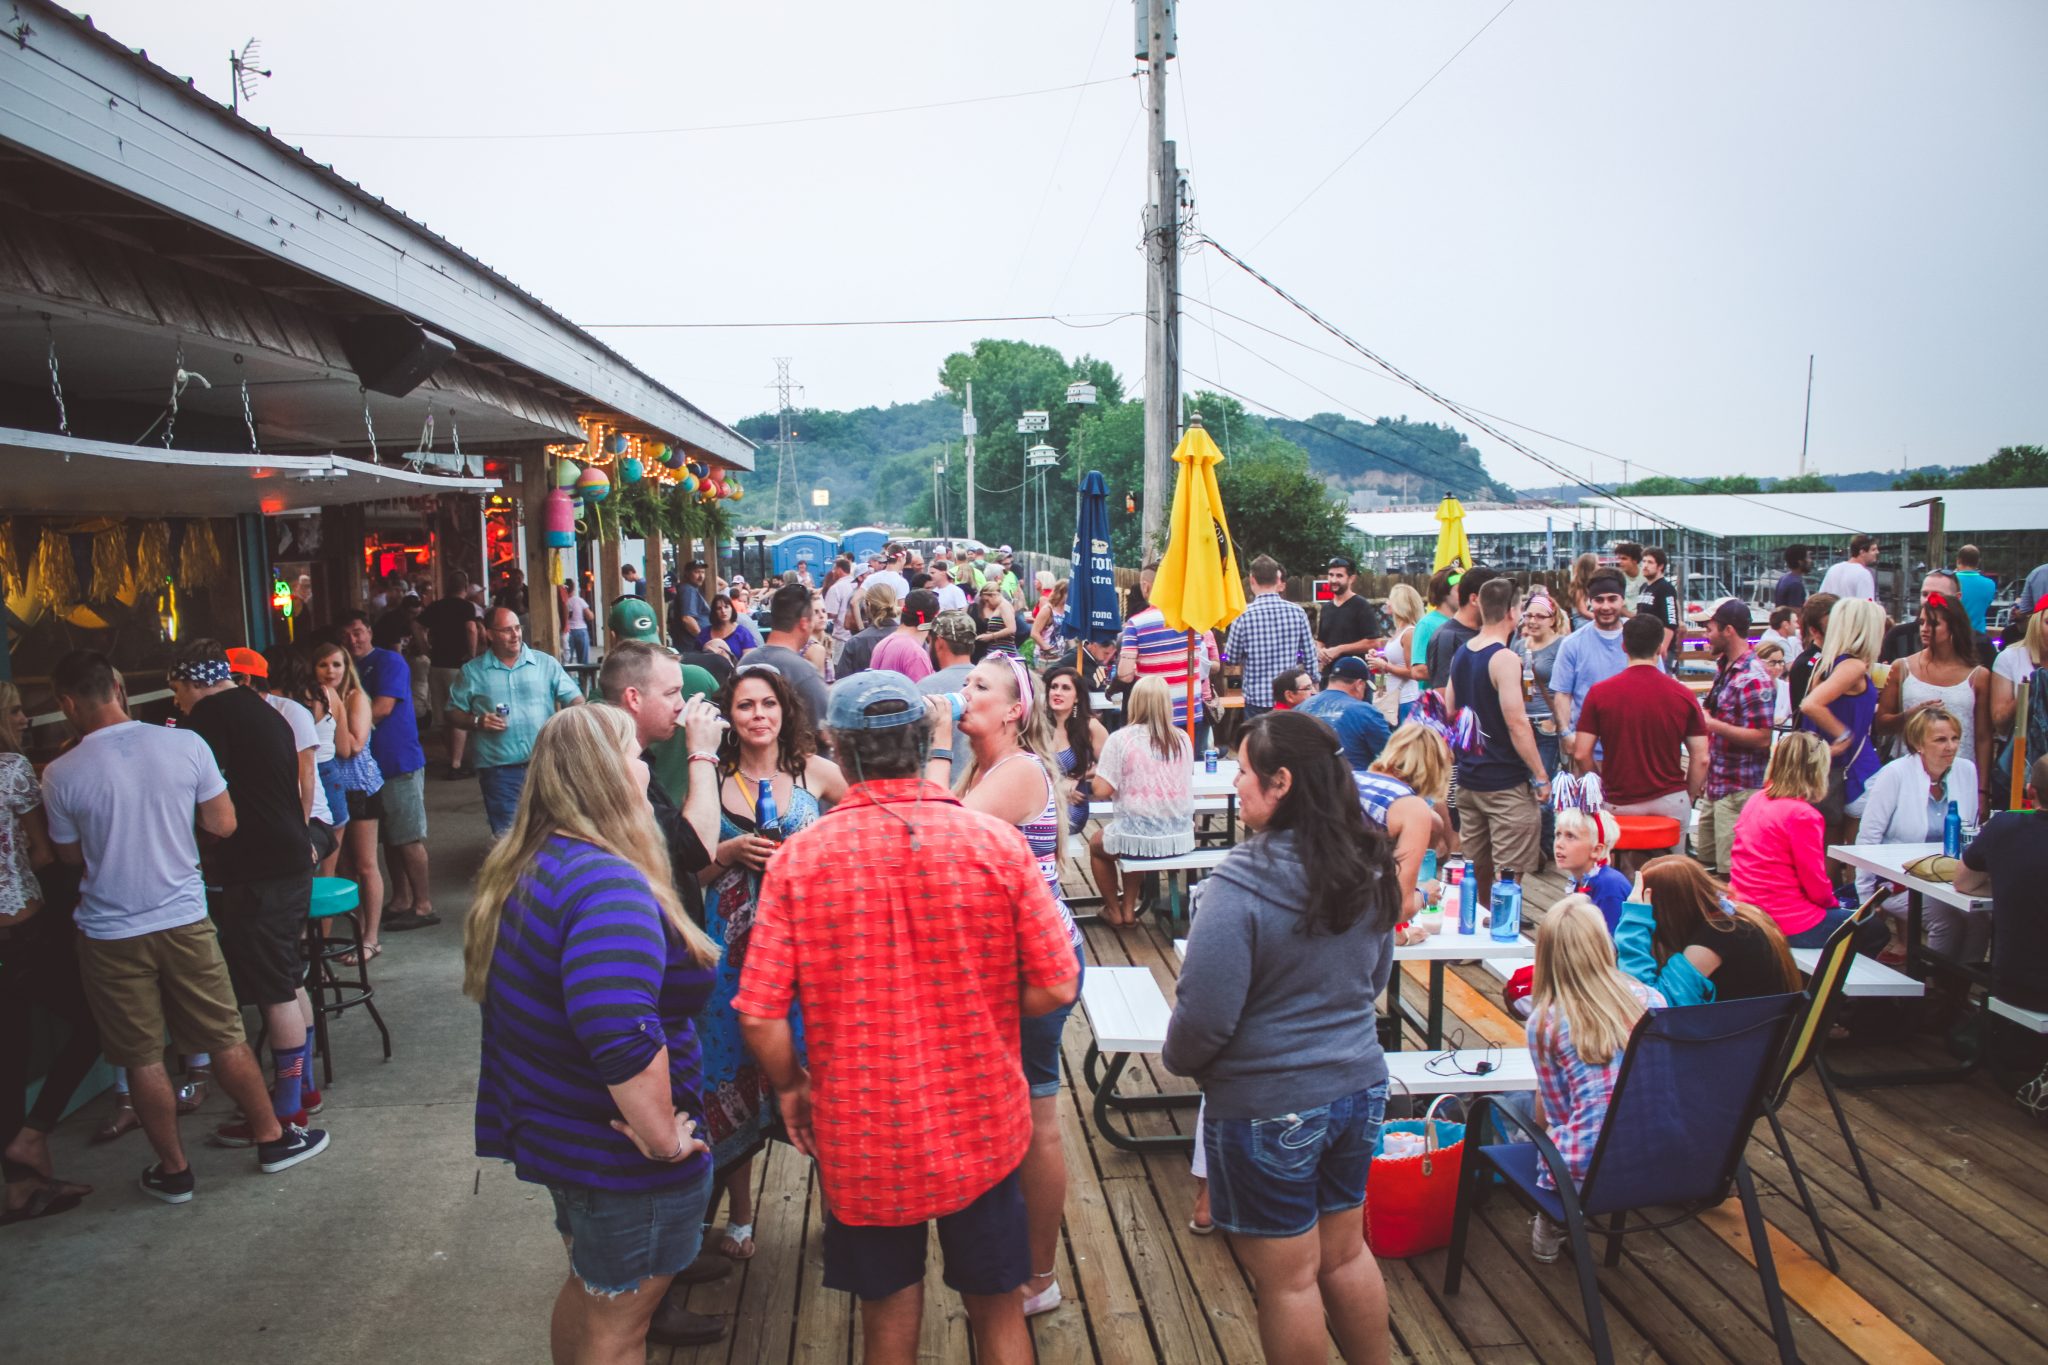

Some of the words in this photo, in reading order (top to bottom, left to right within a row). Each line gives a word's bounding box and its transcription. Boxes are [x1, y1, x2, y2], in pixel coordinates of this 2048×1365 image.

[1091, 556, 1113, 571] ron
[1091, 575, 1112, 585] xtra
[1092, 610, 1112, 620] rona
[634, 617, 652, 629] G
